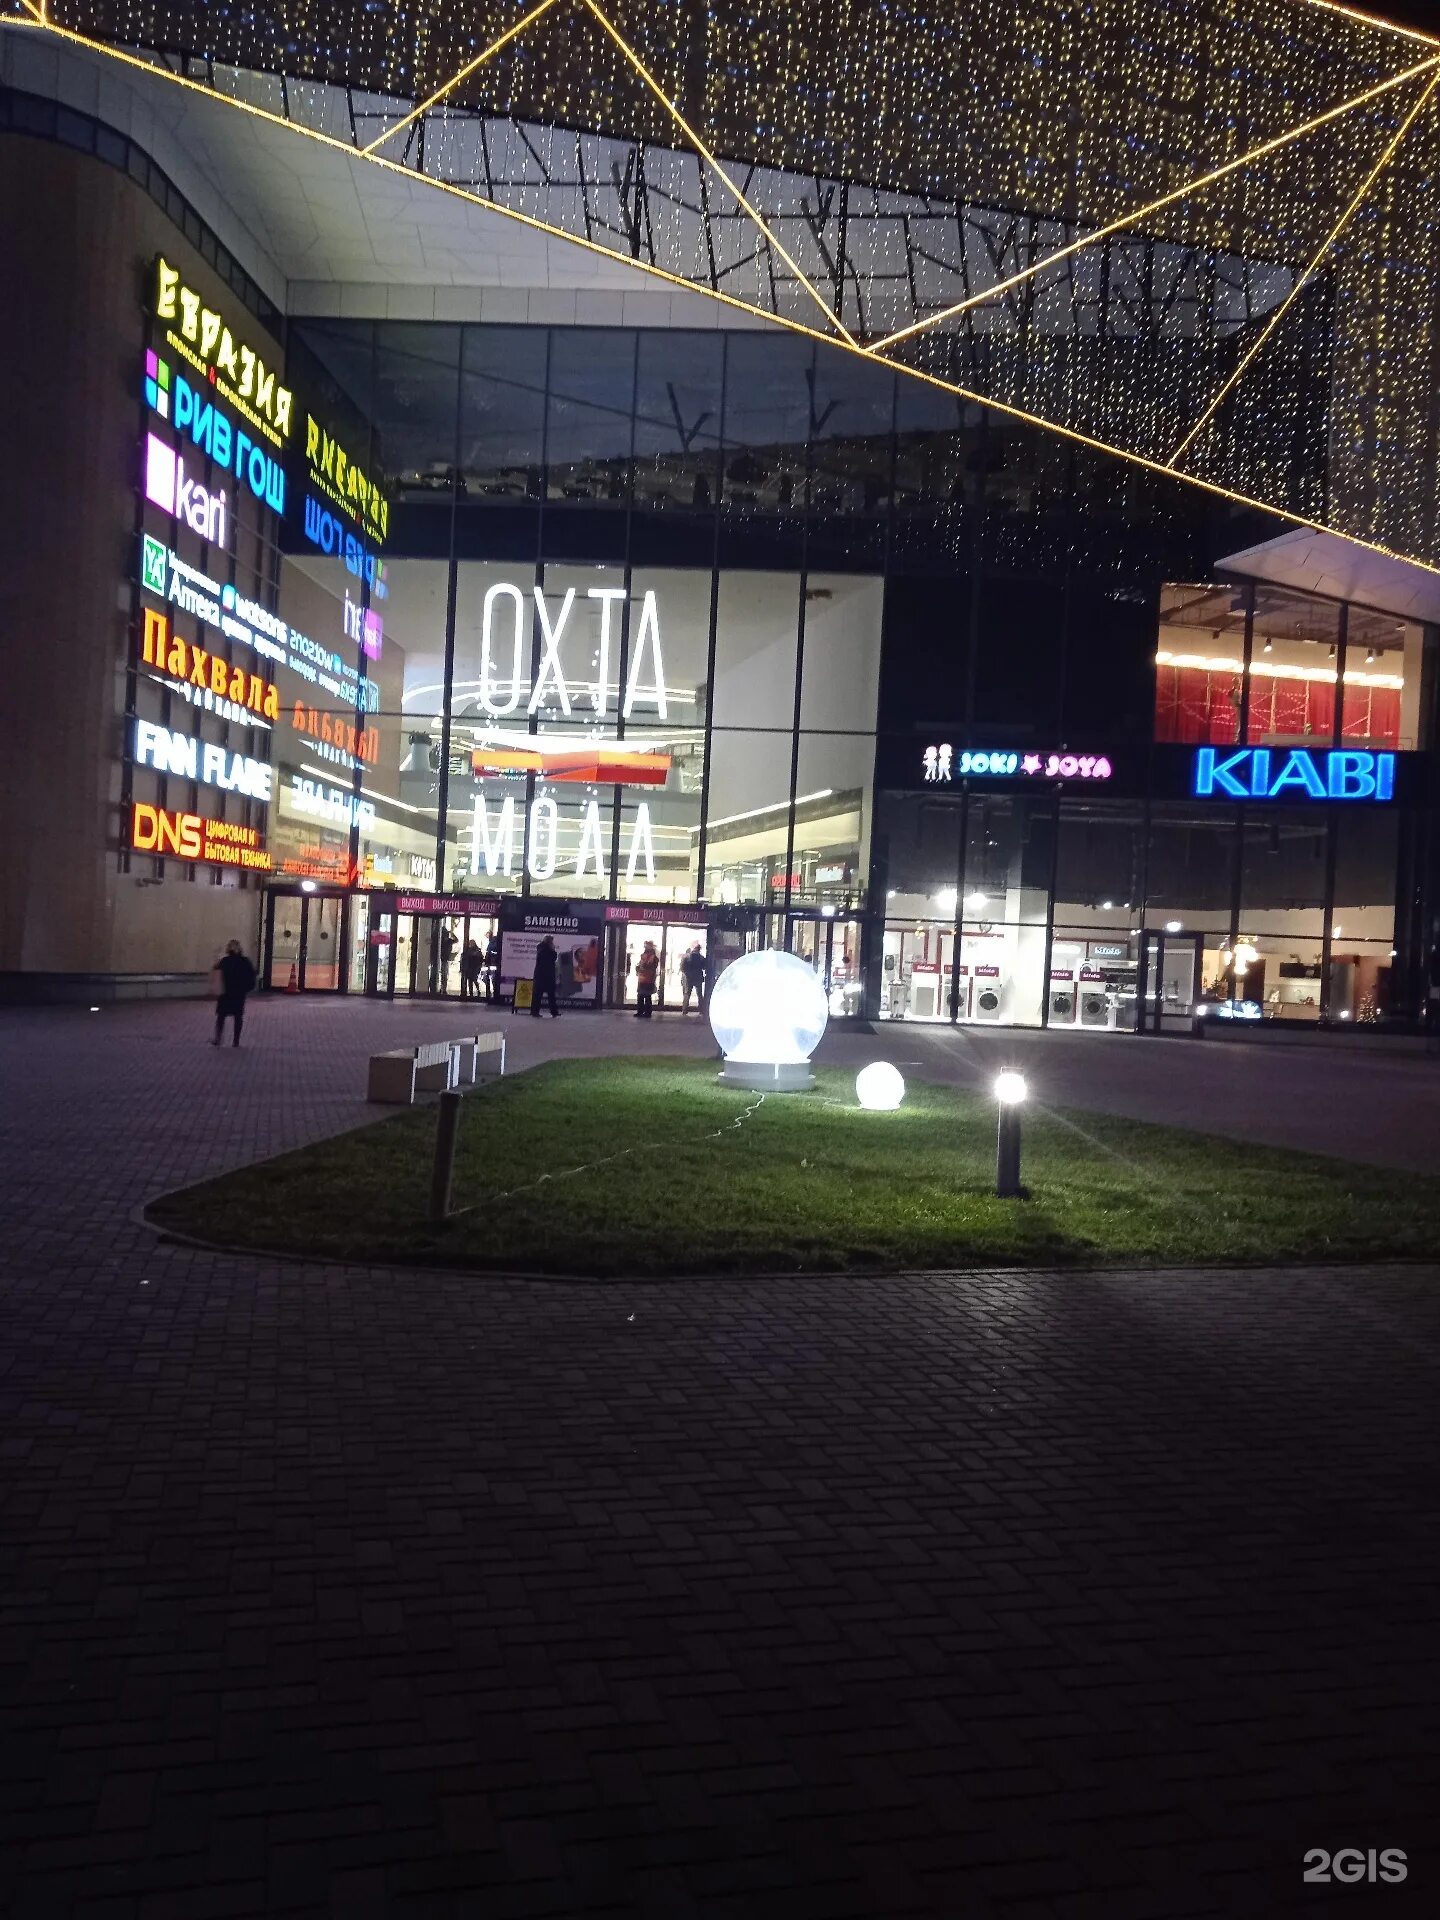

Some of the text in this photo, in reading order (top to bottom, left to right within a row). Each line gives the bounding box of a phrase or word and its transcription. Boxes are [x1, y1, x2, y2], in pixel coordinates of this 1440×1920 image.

[157, 258, 292, 437] ЕВРАЗИЯ
[175, 374, 231, 469] РИВ
[236, 430, 286, 516] ГОШ
[175, 456, 226, 549] kari
[479, 582, 669, 720] ОХТА
[203, 742, 273, 802] FLARE
[960, 752, 1112, 779] JOKI JOYA
[1195, 748, 1396, 800] KIABI
[133, 802, 202, 858] DNS
[204, 841, 240, 865] БЫТОВАЯ
[240, 847, 272, 870] ТЕХНИКА
[205, 818, 257, 847] ЦИФРОВАЯ И
[401, 898, 496, 913] ВЫХОД ВЫХОД ВЫХОД
[524, 915, 579, 927] SAMSUNG
[610, 907, 699, 922] ВХОД ВХОД ВХОД
